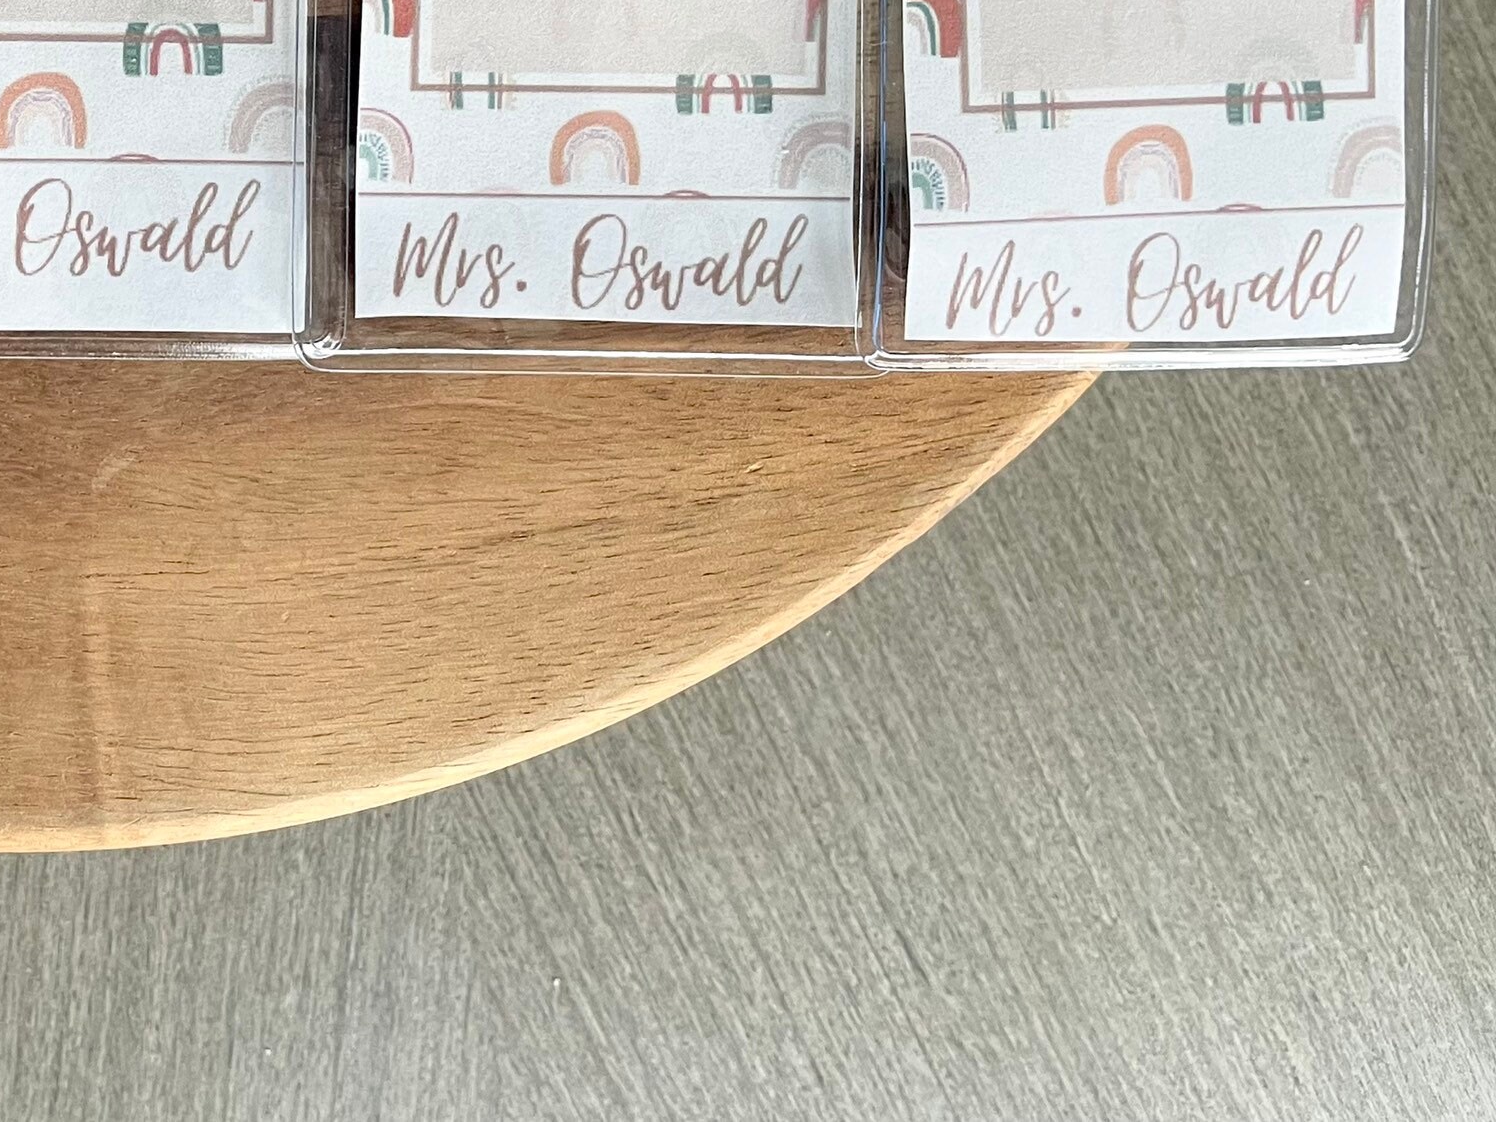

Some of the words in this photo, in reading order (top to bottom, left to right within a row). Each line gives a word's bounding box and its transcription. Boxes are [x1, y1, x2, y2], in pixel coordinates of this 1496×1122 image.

[14, 177, 263, 275] Oswald
[394, 214, 528, 309] Mrs.
[570, 211, 807, 309] Oswald
[945, 239, 1083, 338] Mrs.
[1124, 222, 1364, 332] Oswald
